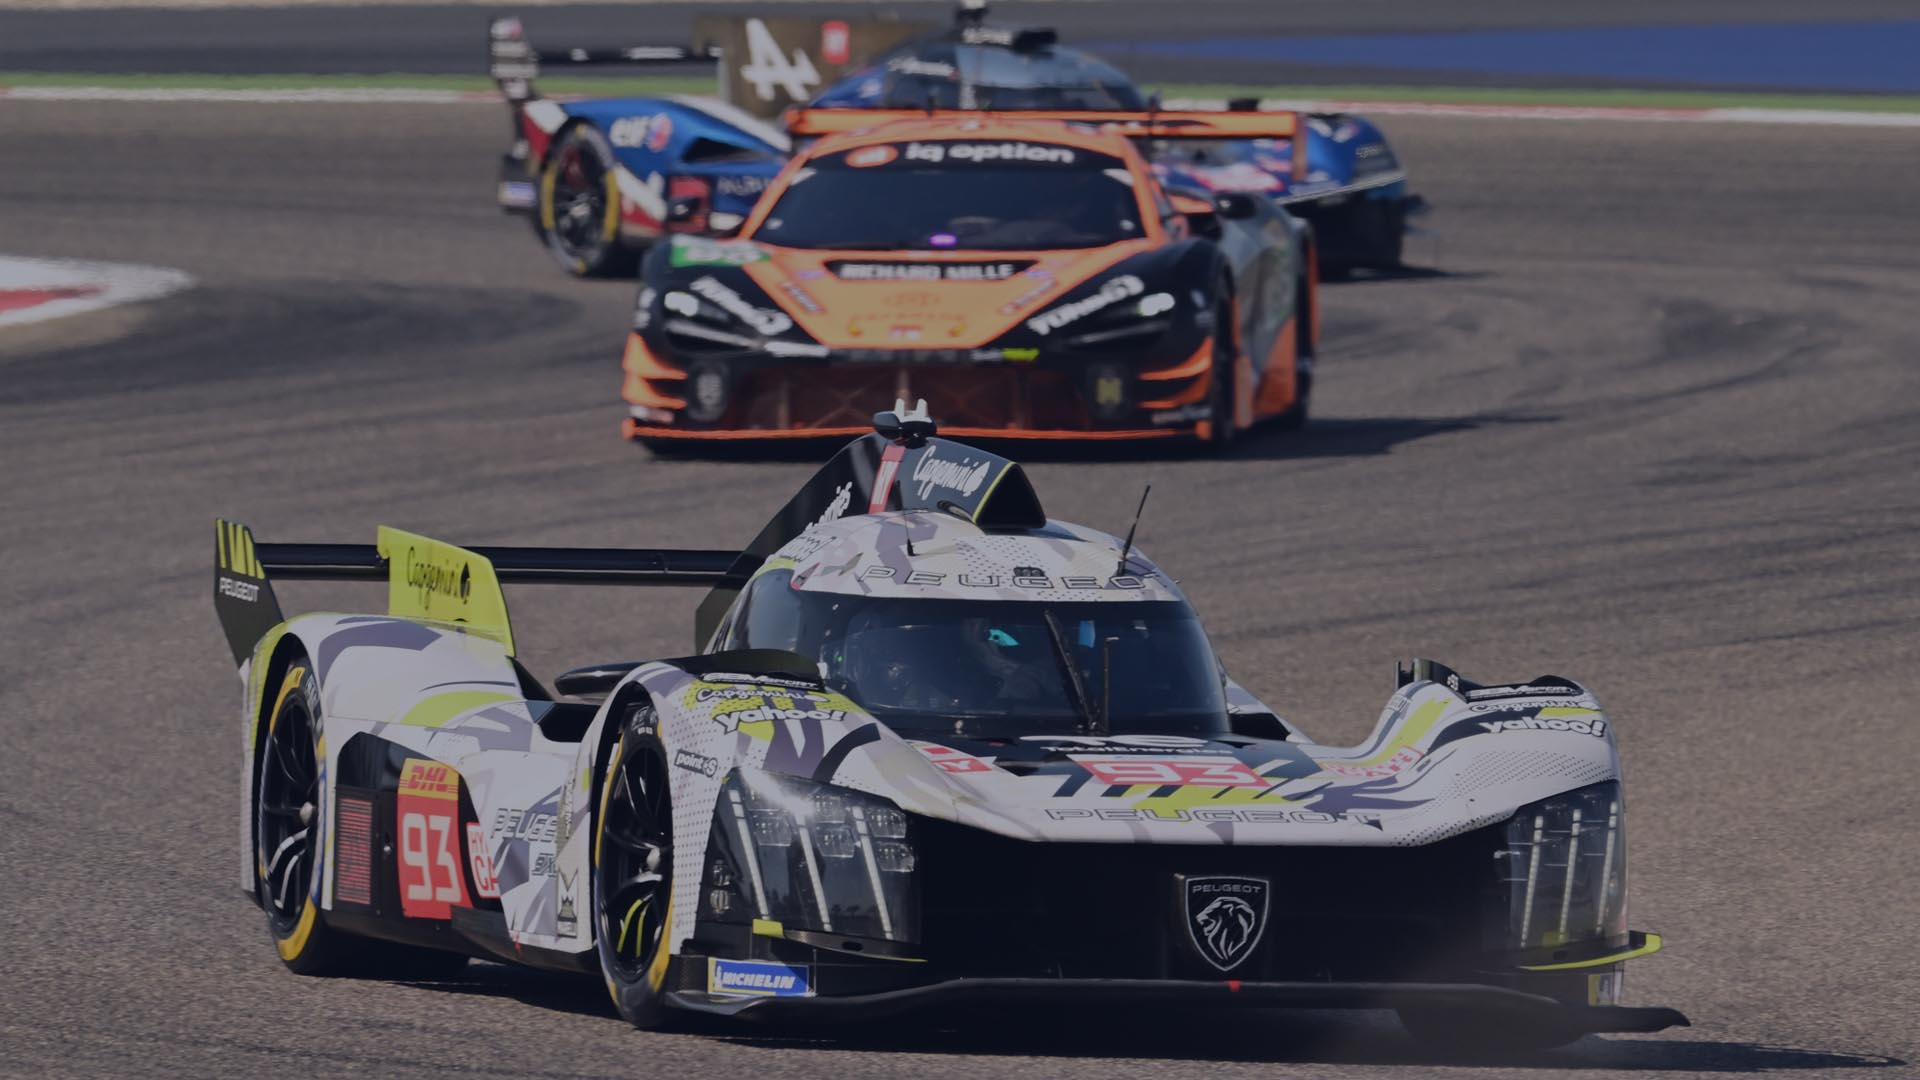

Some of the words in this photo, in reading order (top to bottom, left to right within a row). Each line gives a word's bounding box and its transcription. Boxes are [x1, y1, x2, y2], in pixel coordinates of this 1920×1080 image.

[949, 142, 1076, 164] option
[839, 263, 941, 280] RICHARD
[945, 263, 1015, 280] MILLE
[218, 576, 260, 603] PEUGEOT
[696, 686, 806, 701] Capgemini
[1469, 700, 1580, 713] Capgemini
[712, 704, 847, 735] yahoo!
[1478, 715, 1607, 737] yahoo!
[407, 764, 450, 792] DHL
[1092, 762, 1257, 784] 93
[1044, 807, 1382, 824] PEUGEOT
[402, 812, 463, 903] 93
[1192, 883, 1262, 894] PEUGEOT
[721, 970, 797, 990] MICHELIN
